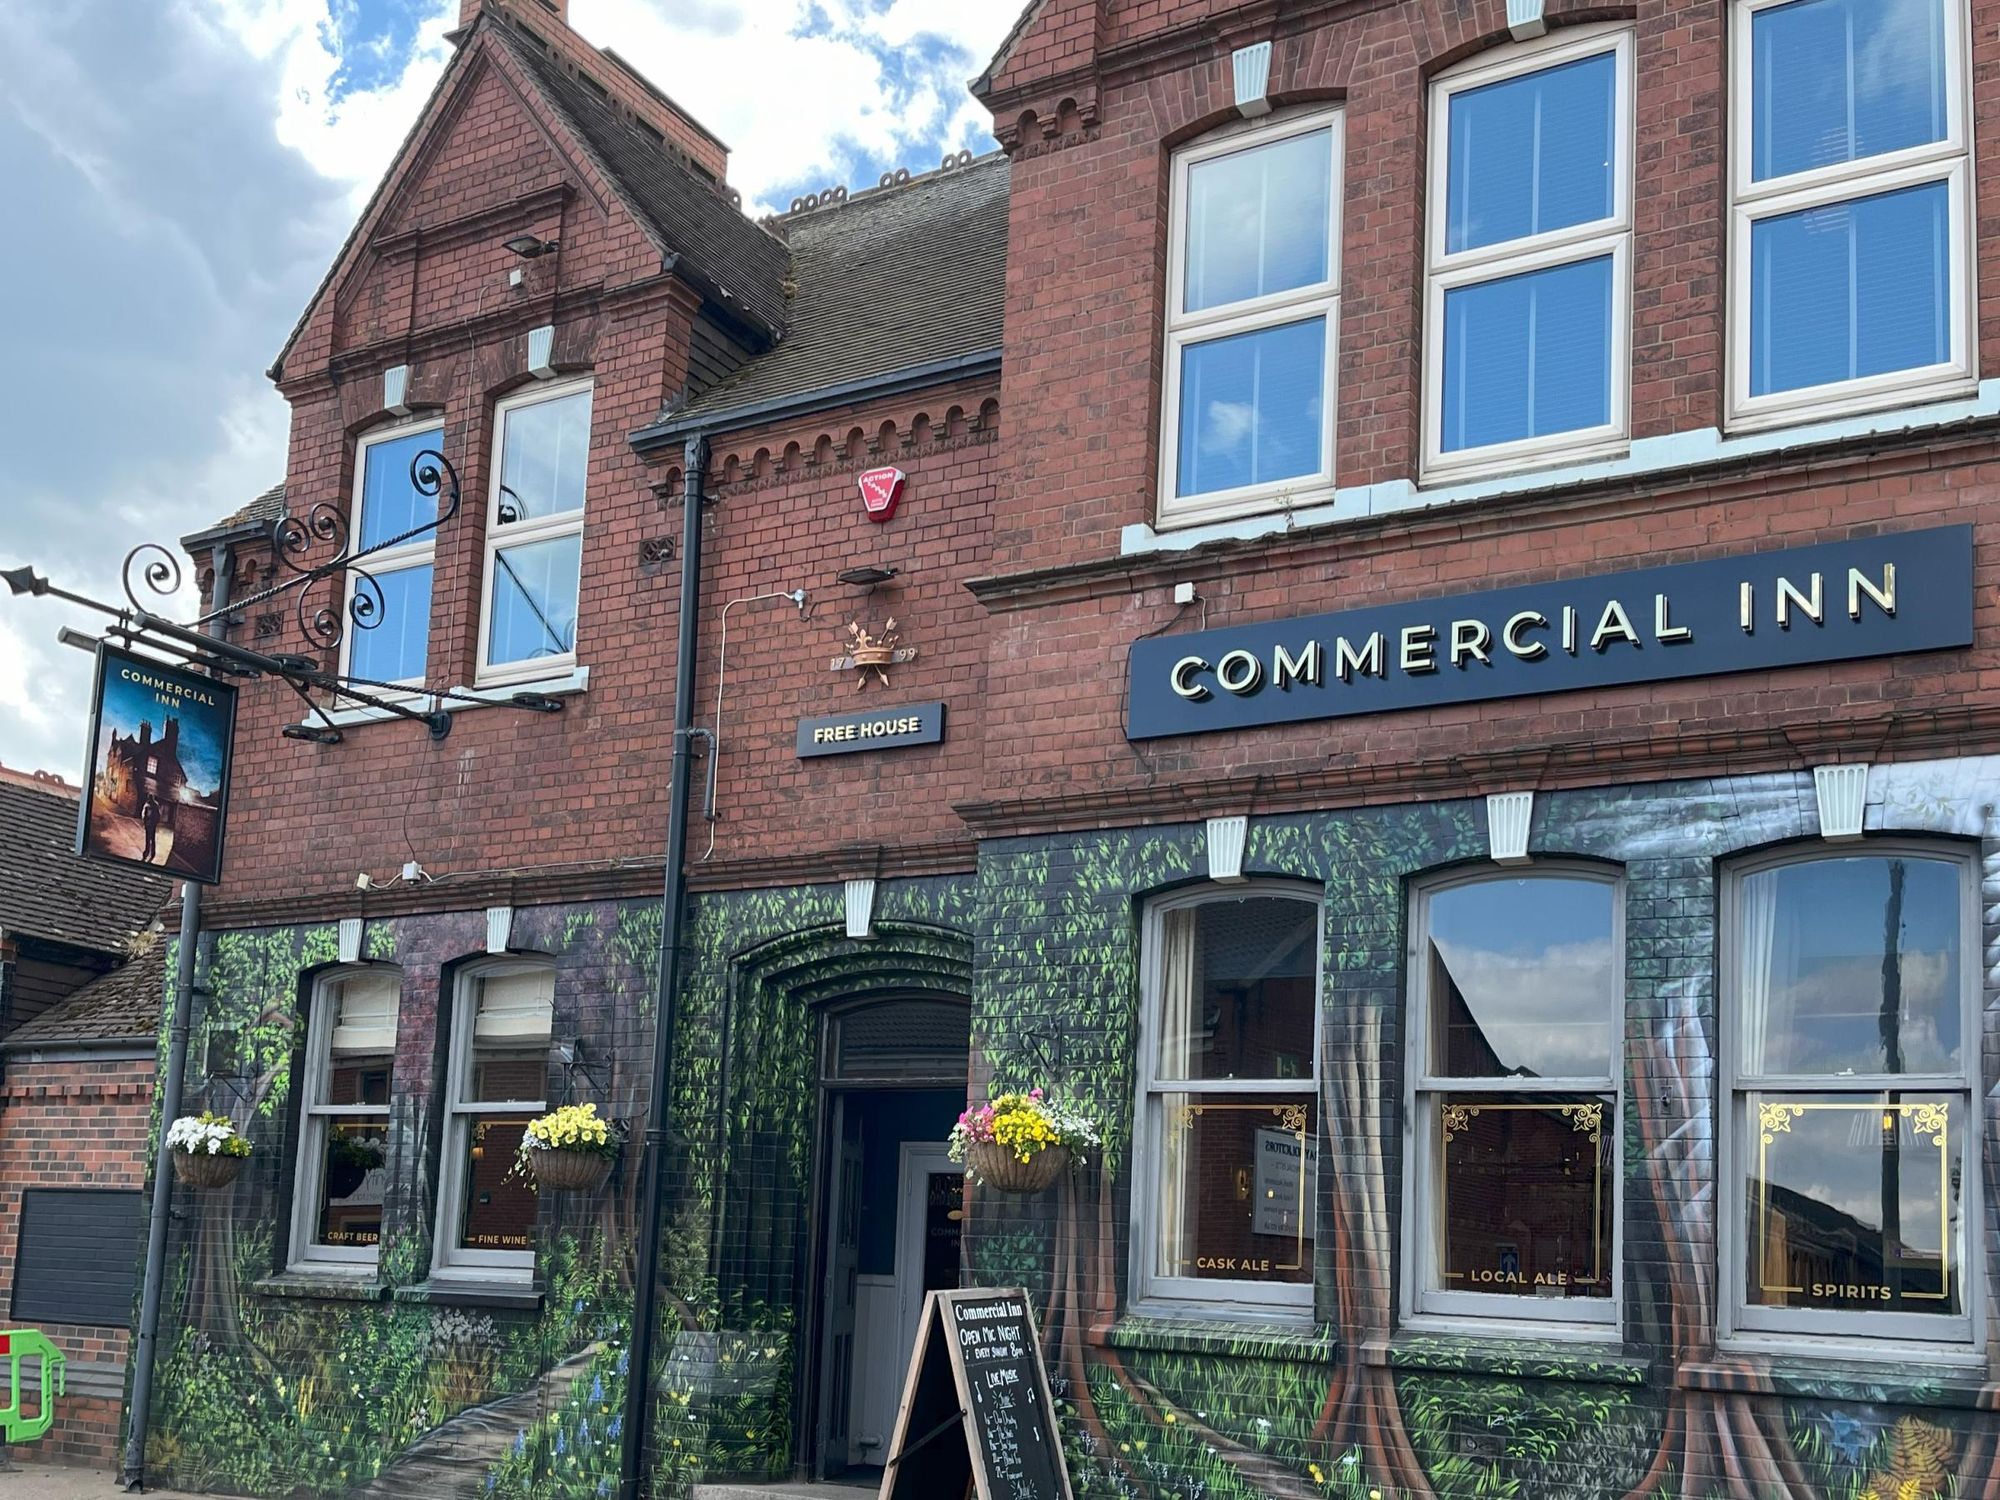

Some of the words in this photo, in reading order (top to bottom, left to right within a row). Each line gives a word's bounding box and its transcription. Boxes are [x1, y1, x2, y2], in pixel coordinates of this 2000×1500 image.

[863, 472, 893, 483] ACTION
[1171, 594, 1691, 699] COMMERCIAL
[1739, 563, 1896, 632] INN
[830, 657, 845, 668] 17
[899, 648, 915, 660] 99
[121, 668, 215, 706] COMMERCIAL
[155, 693, 180, 708] INN
[814, 724, 856, 743] FREE
[860, 716, 920, 738] HOUSE
[327, 1231, 354, 1241] CRAFT
[356, 1232, 379, 1242] BEER
[478, 1234, 499, 1244] FINE
[502, 1235, 527, 1245] WINE
[1197, 1257, 1235, 1270] CASK
[1241, 1259, 1270, 1272] ALE
[1471, 1269, 1528, 1284] LOCAL
[1534, 1272, 1567, 1286] ALE
[1812, 1283, 1892, 1300] SPIRITS
[955, 1301, 1007, 1321] Commercial
[1007, 1301, 1023, 1317] Inn
[960, 1328, 981, 1345] OPEN
[982, 1326, 996, 1343] MIC
[997, 1325, 1020, 1342] NIGHT
